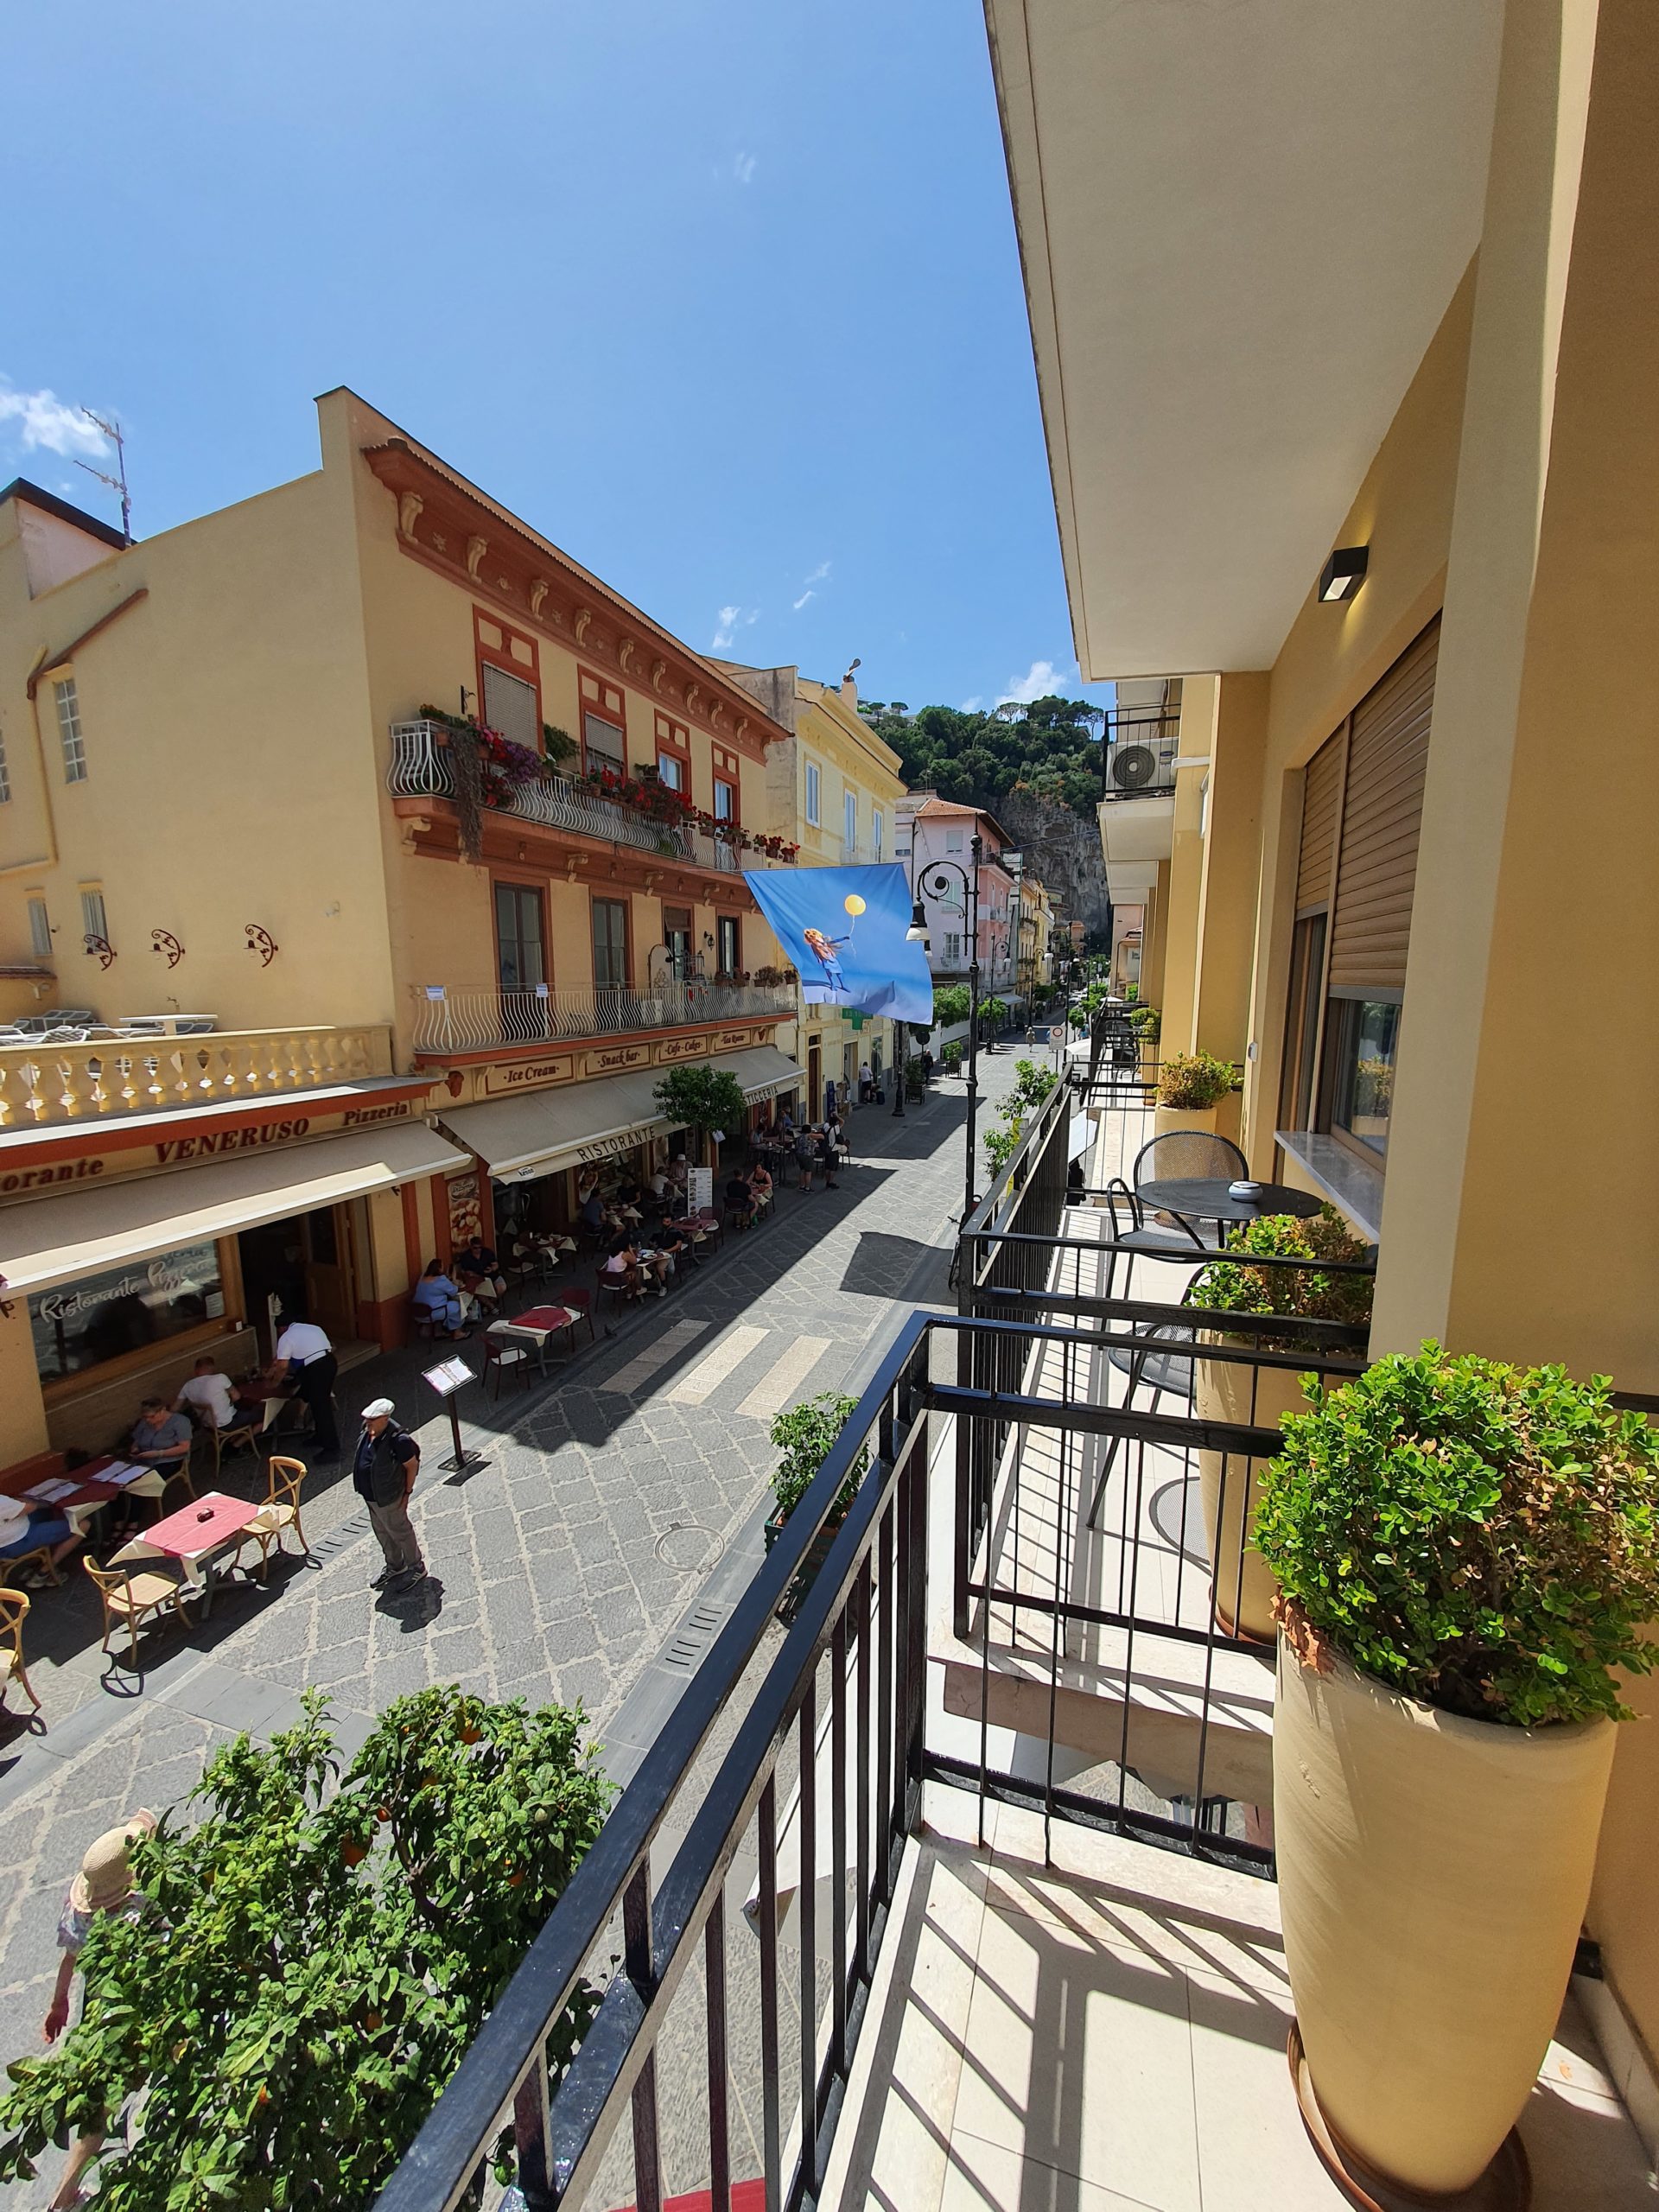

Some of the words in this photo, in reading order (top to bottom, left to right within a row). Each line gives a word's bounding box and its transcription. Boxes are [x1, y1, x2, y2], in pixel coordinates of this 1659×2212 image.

[600, 1050, 626, 1068] Snack
[626, 1049, 638, 1062] bar
[507, 1070, 523, 1083] Ice
[524, 1065, 557, 1081] Cream
[746, 1085, 779, 1105] TICCERIA
[0, 1158, 105, 1192] orante
[154, 1117, 310, 1164] VENERUSO
[342, 1102, 409, 1127] Pizzeria
[576, 1126, 656, 1161] RISTORANTE
[40, 1275, 139, 1323] Ristorante
